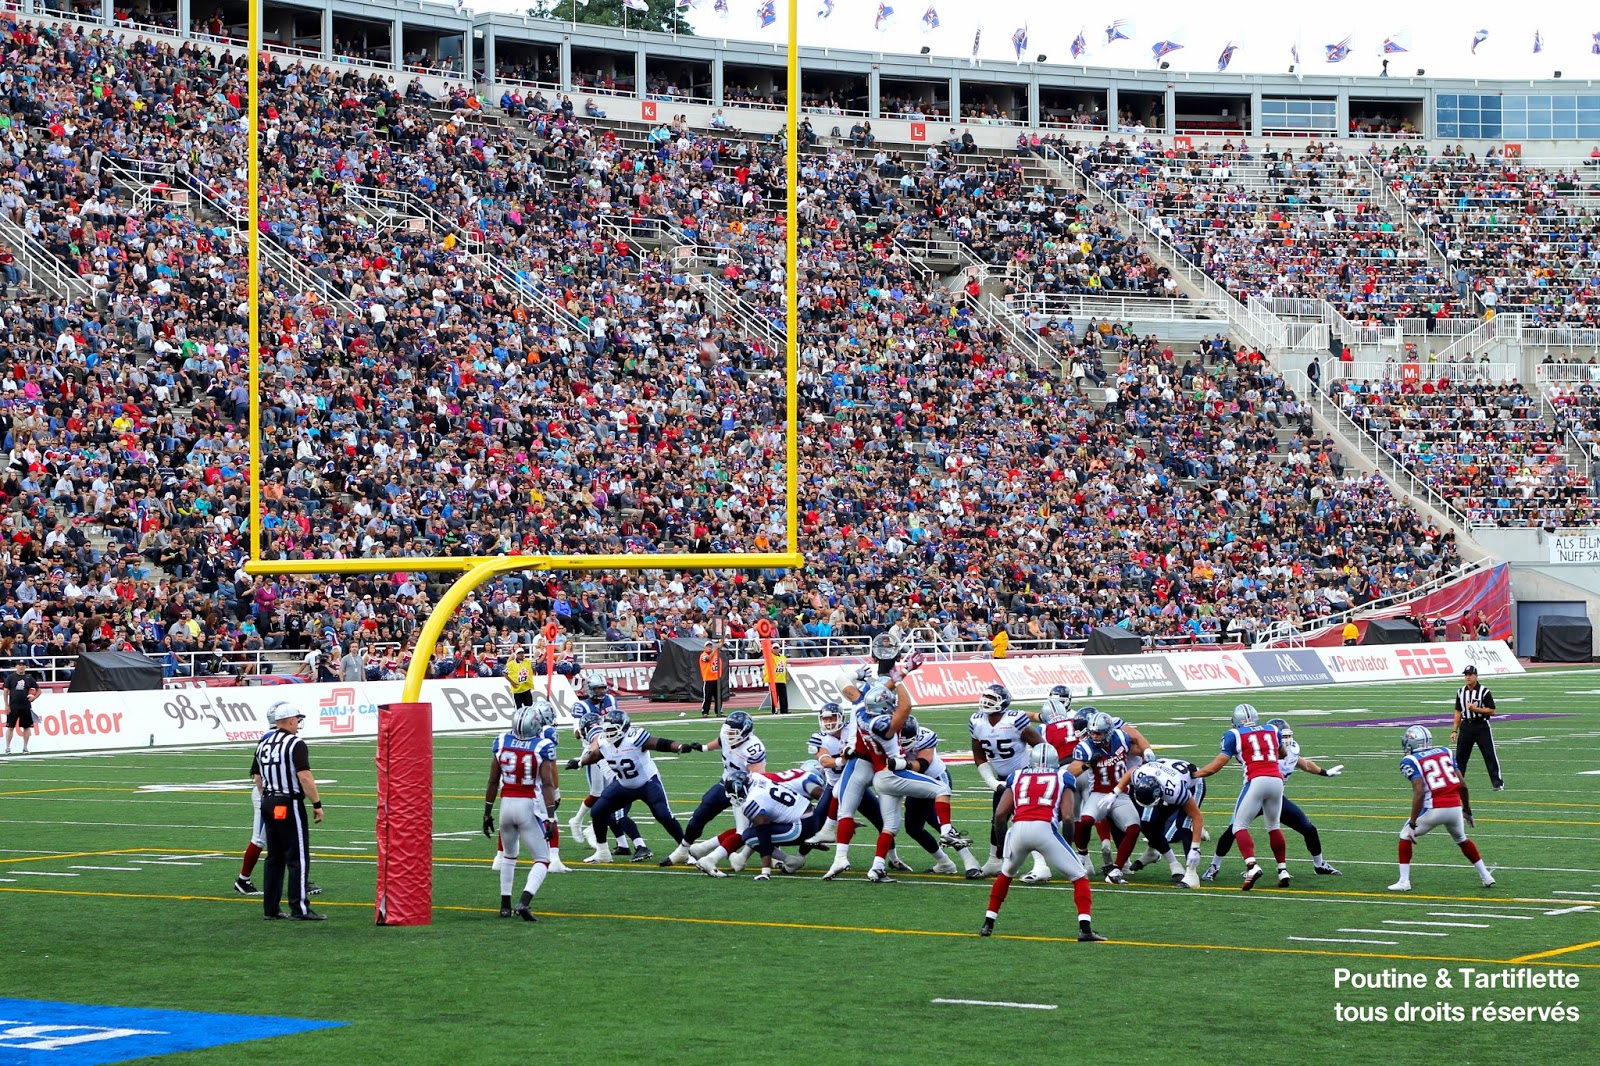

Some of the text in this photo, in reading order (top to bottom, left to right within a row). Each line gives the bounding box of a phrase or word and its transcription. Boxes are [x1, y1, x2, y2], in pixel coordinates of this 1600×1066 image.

[1556, 538, 1575, 549] ALS
[1107, 663, 1168, 682] CARSTAR
[1178, 662, 1227, 681] xerox
[1336, 655, 1389, 673] Purolator
[518, 675, 528, 683] LCF
[907, 668, 946, 698] Tim
[320, 703, 379, 717] AMJ CA
[261, 743, 280, 764] 34
[746, 743, 763, 757] 57
[980, 738, 1015, 760] 65
[1248, 733, 1277, 762] 11
[500, 750, 535, 786] 21
[1022, 767, 1055, 775] PARKER
[1422, 755, 1461, 790] 26
[1017, 775, 1058, 807] 17
